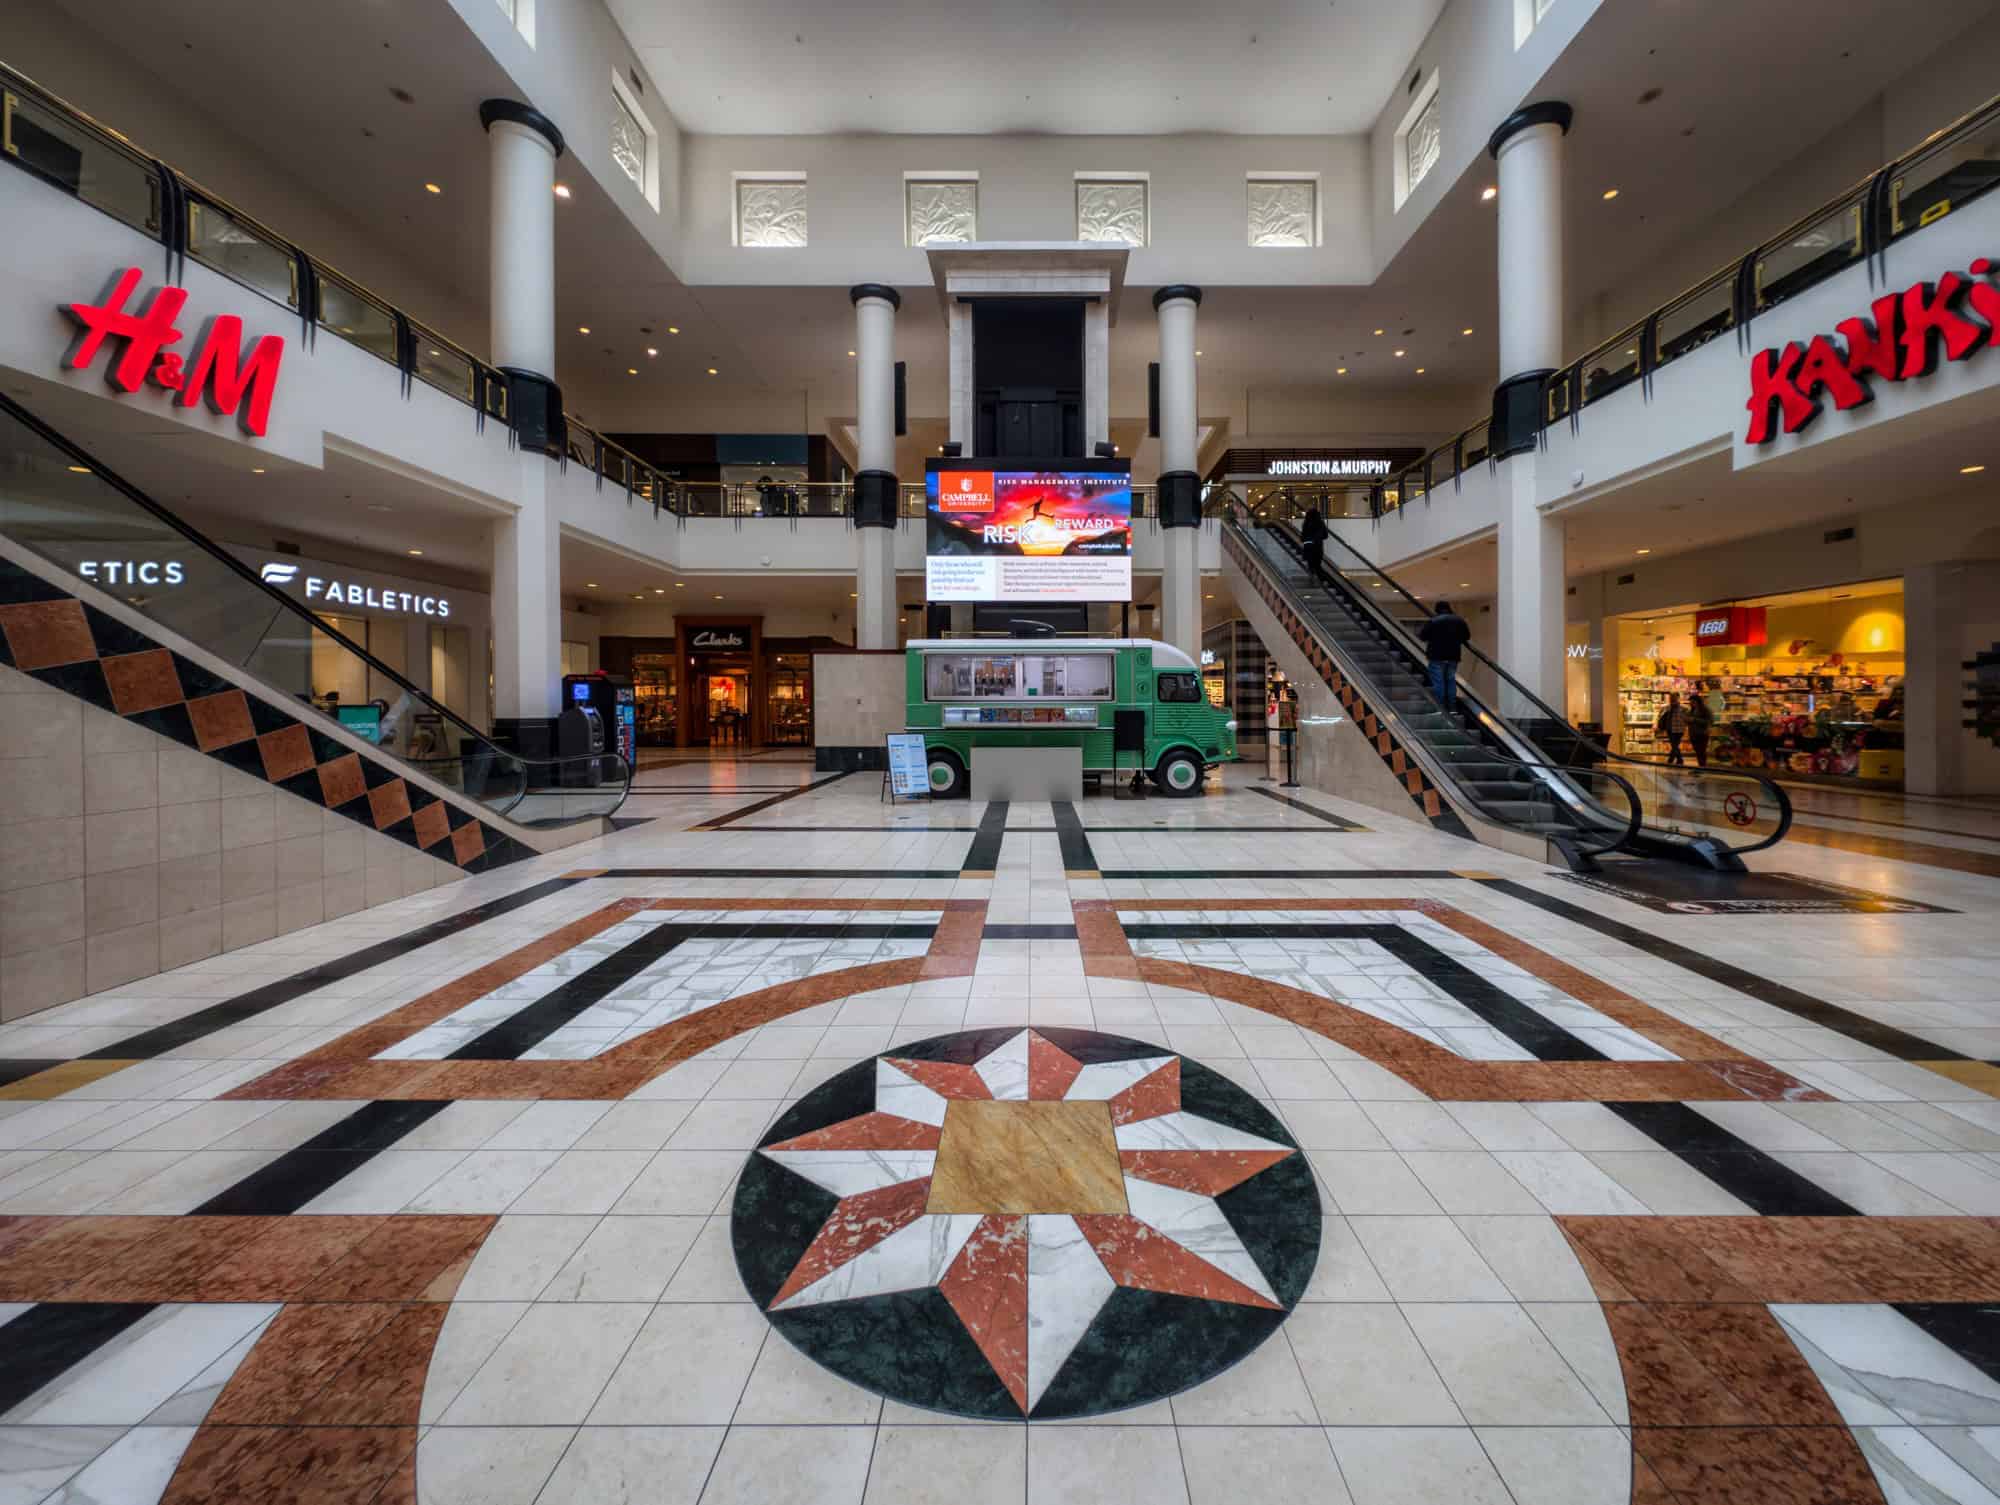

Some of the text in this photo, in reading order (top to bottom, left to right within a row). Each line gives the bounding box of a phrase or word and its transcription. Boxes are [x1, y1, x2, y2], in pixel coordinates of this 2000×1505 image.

[66, 266, 285, 438] H&M
[942, 493, 992, 502] CAMPBELL
[1055, 518, 1114, 529] REWARD
[983, 525, 1033, 544] RISK
[305, 577, 450, 617] FABLETICS
[1698, 619, 1729, 636] LEGO
[693, 631, 743, 646] Clarks
